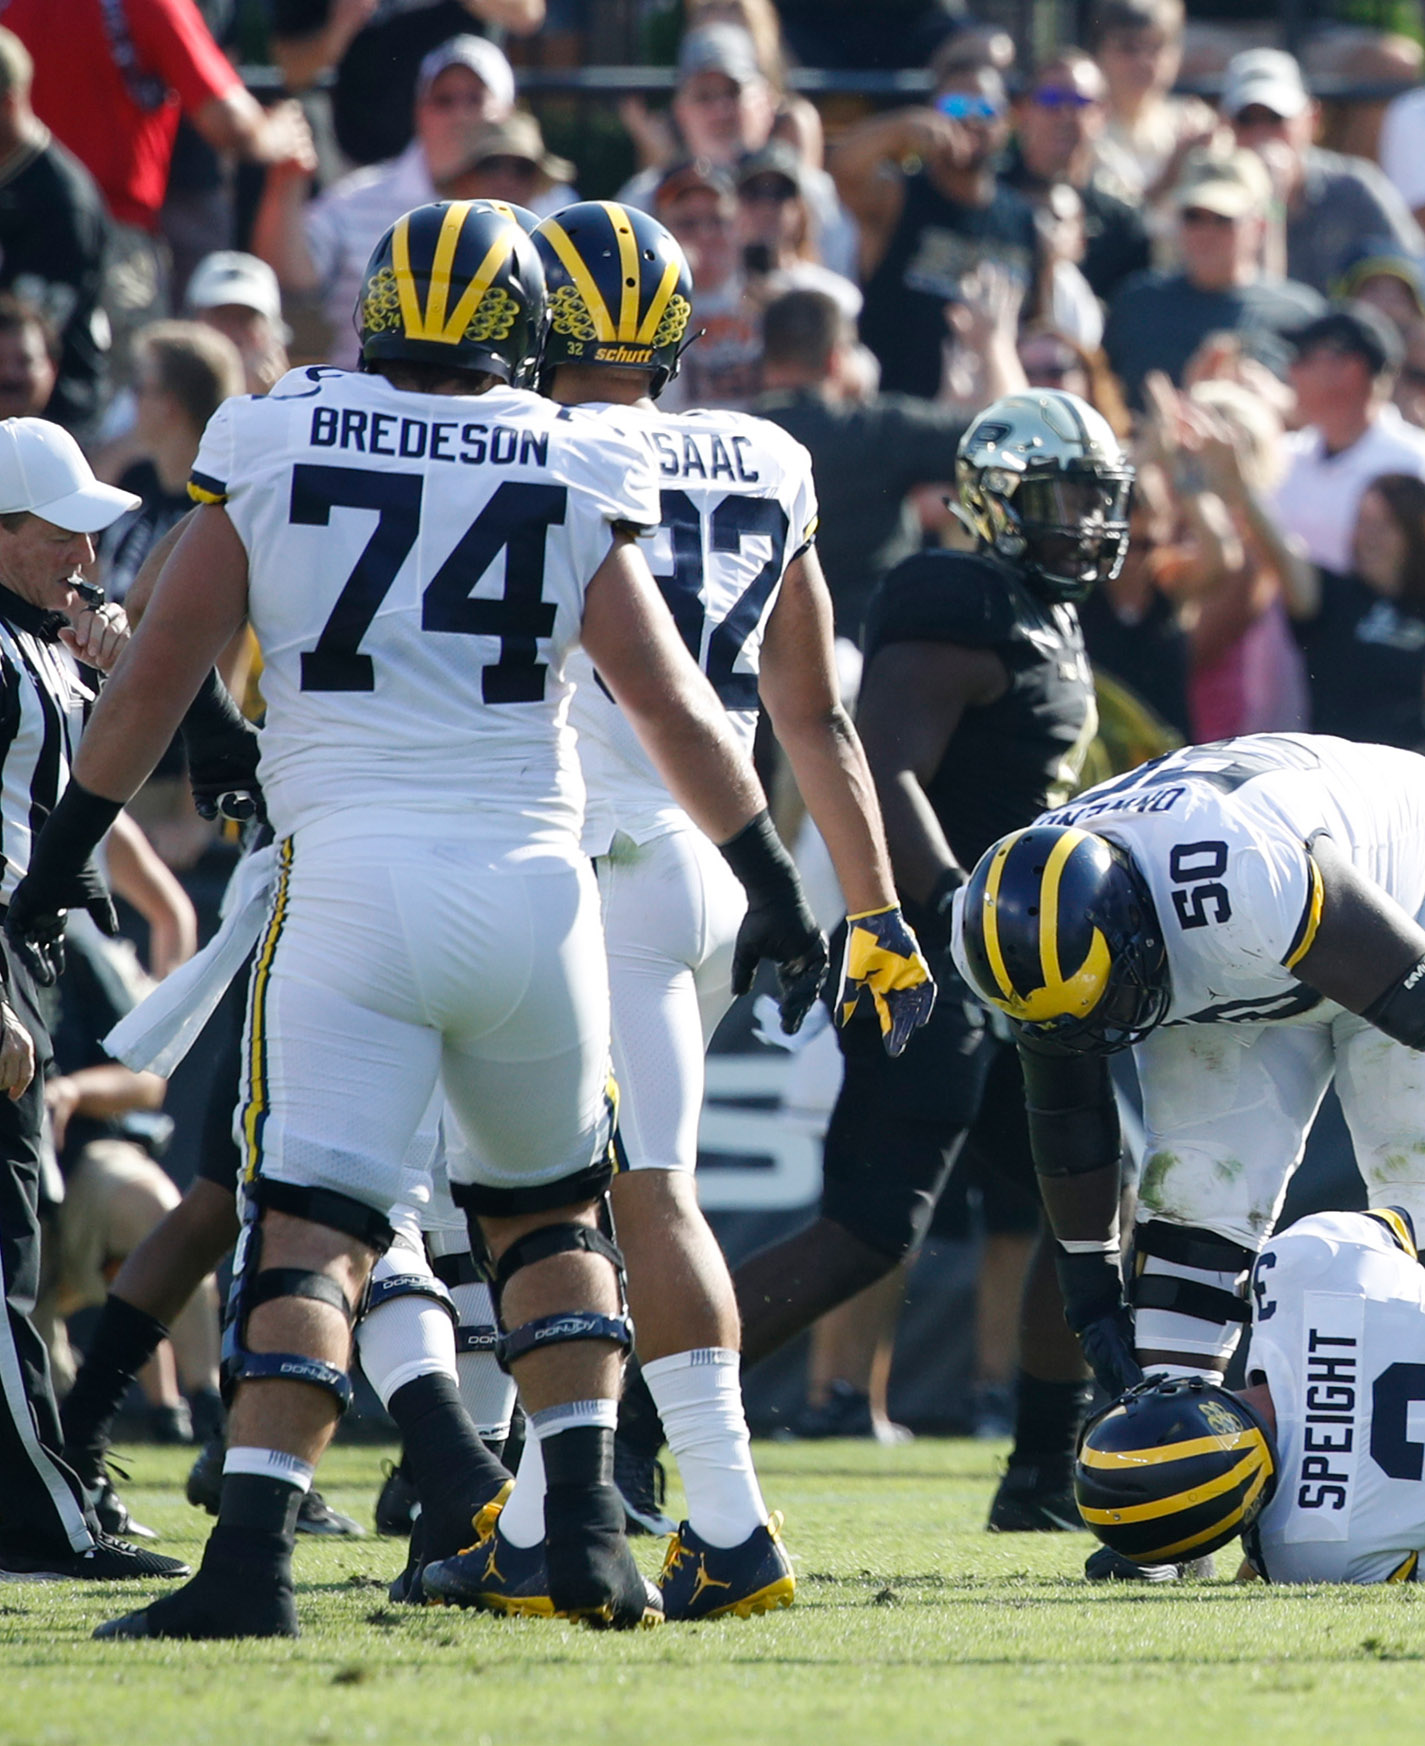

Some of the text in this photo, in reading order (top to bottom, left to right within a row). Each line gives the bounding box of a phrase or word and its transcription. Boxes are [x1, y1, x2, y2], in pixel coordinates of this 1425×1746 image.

[567, 341, 583, 356] 32
[594, 346, 653, 363] schutt
[309, 406, 549, 467] BREDESON
[289, 463, 567, 704] 74
[1169, 841, 1232, 930] 50
[1253, 1251, 1277, 1322] 3
[1298, 1328, 1357, 1510] SPEIGHT
